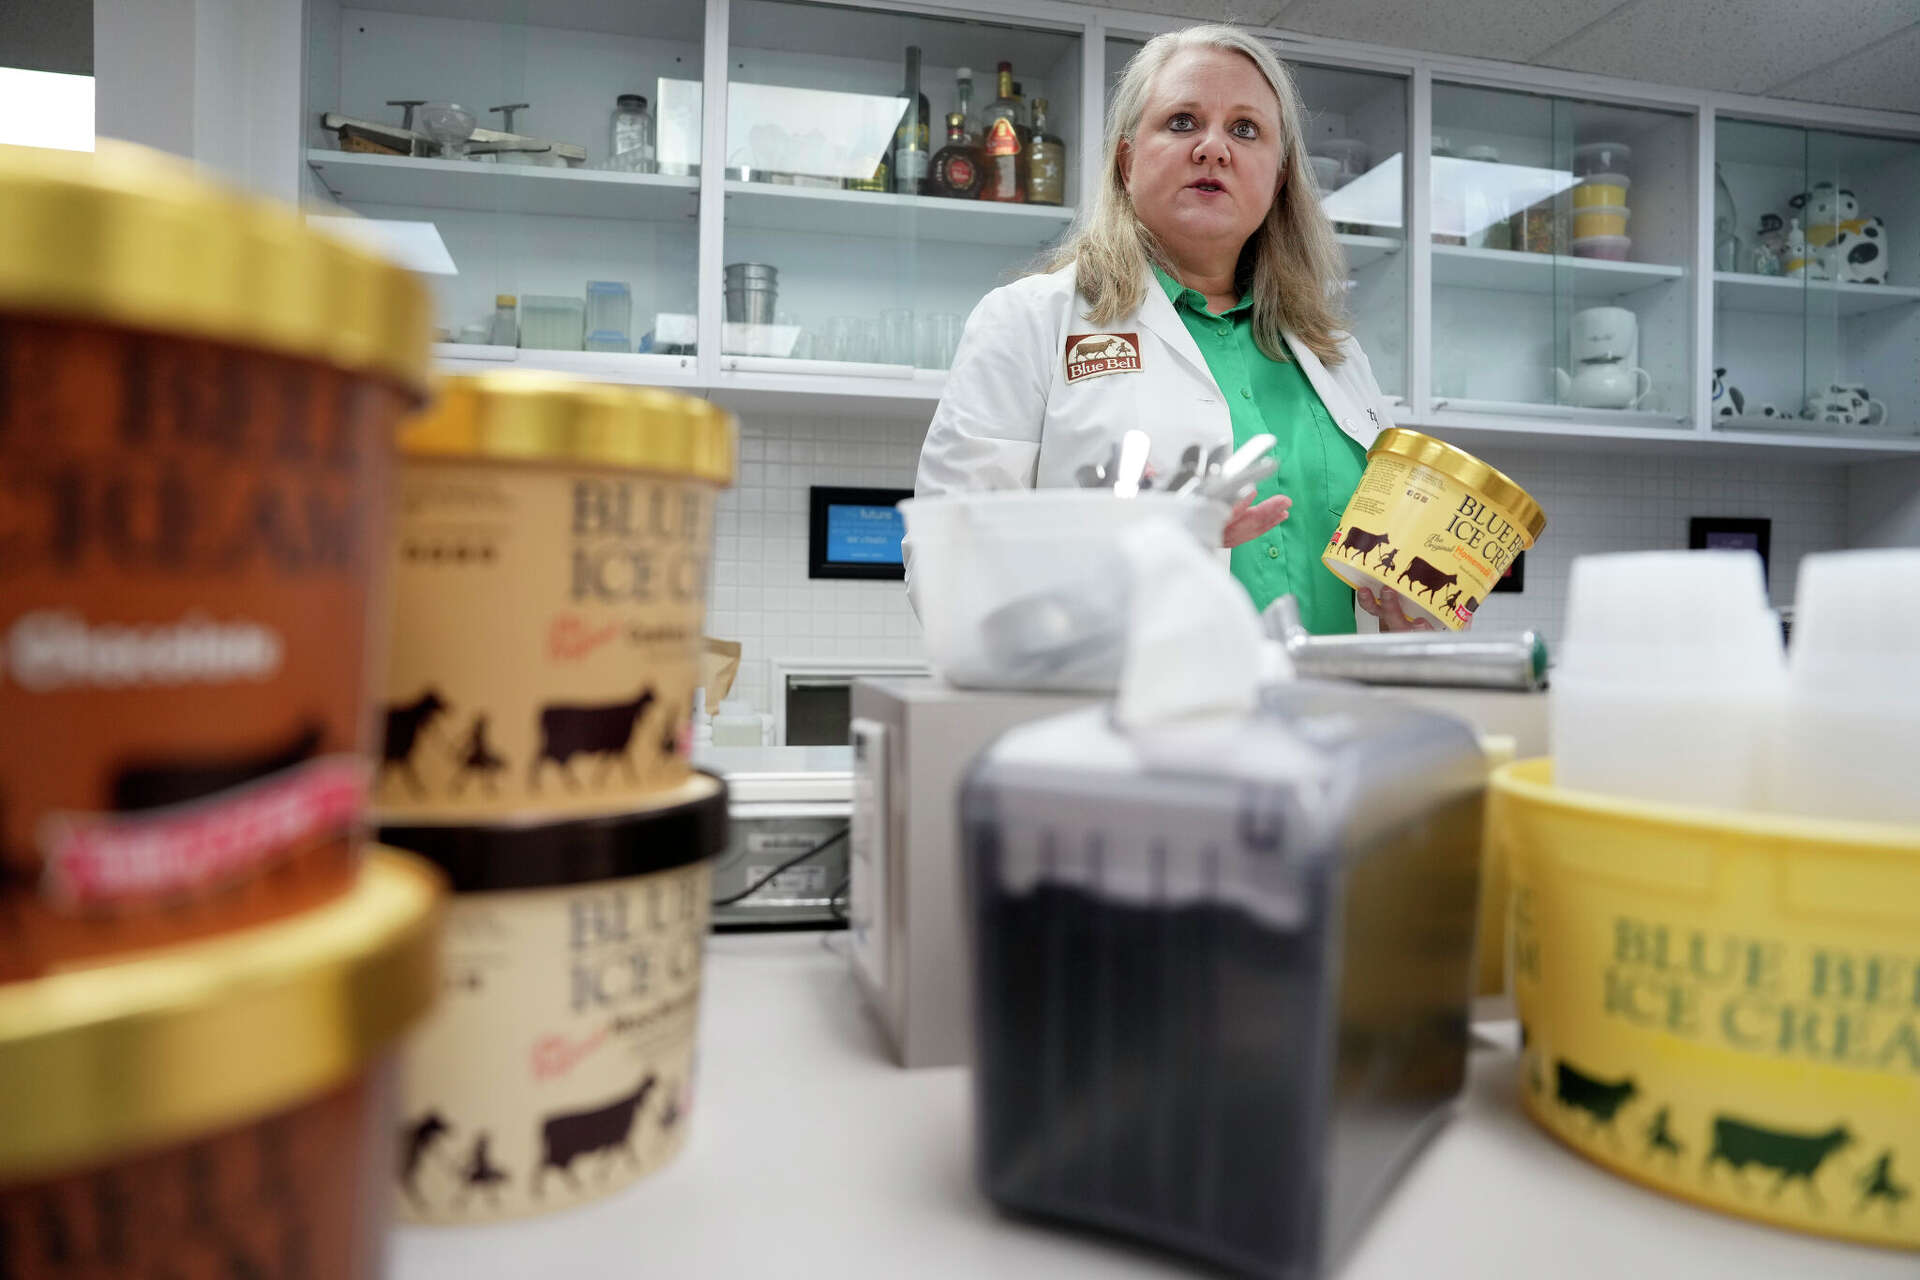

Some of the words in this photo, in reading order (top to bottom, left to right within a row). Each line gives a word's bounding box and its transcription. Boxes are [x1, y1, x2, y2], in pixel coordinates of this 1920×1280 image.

[1070, 361, 1104, 379] Blue
[1106, 357, 1137, 369] Bell
[1445, 515, 1486, 549] ICE
[1456, 494, 1514, 543] BLUE
[1613, 916, 1785, 993] BLUE
[1810, 945, 1920, 1010] BE
[1603, 965, 1700, 1035] ICE
